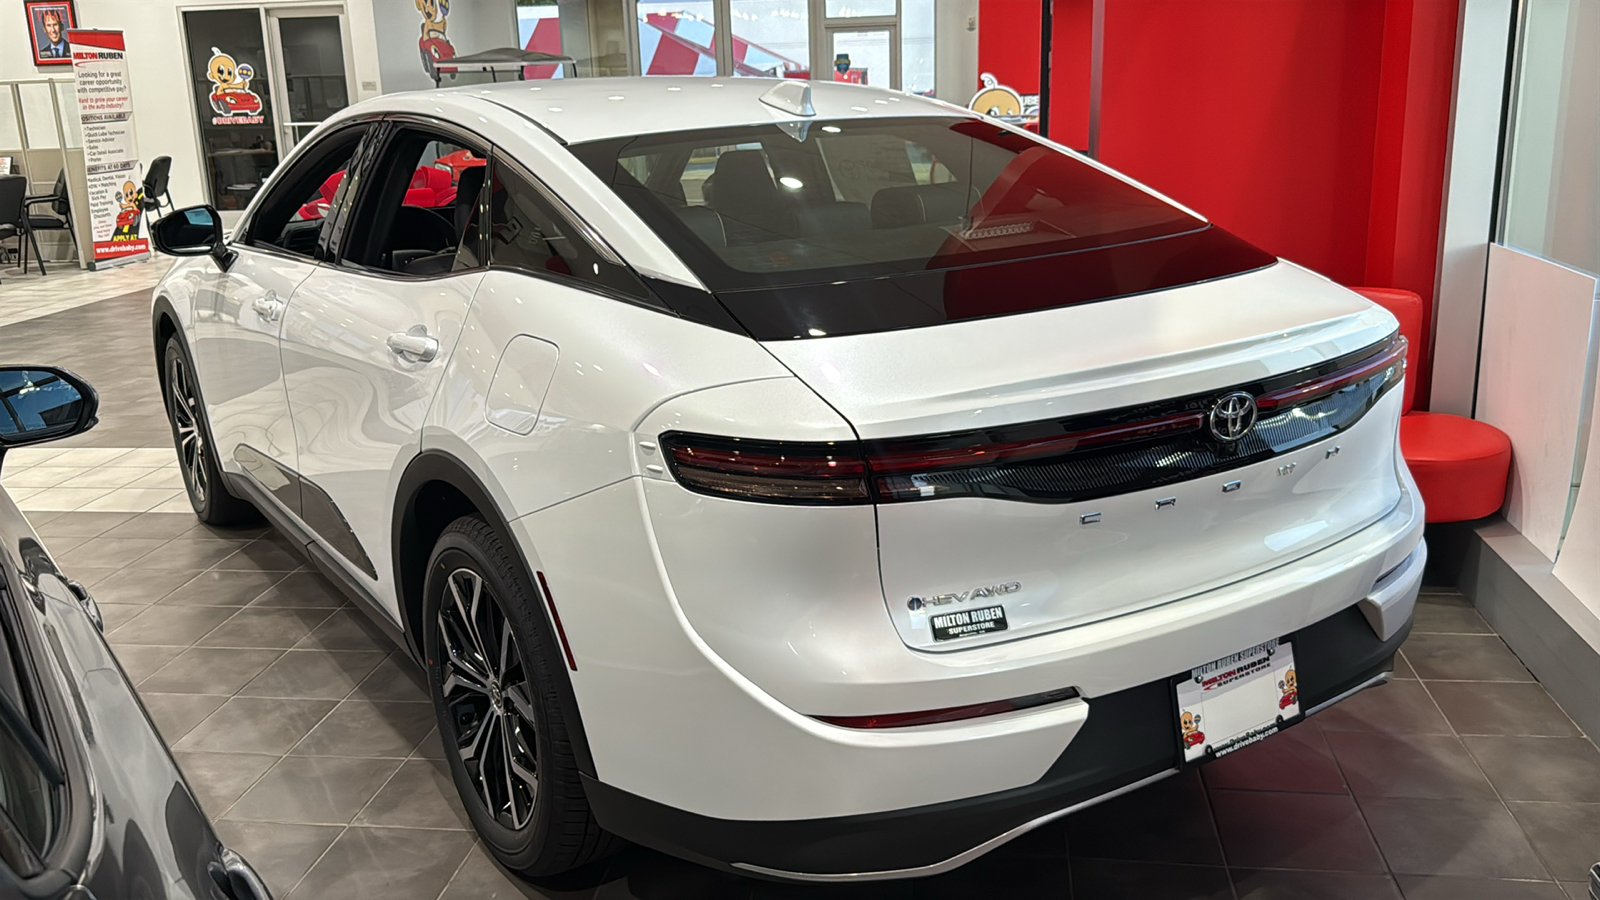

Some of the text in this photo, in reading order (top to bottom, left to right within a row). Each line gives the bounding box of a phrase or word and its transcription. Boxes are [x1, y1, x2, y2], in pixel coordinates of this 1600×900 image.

[36, 10, 67, 22] TIME
[96, 244, 146, 253] www.drivebaby.com
[921, 581, 1021, 607] HEV AWD
[933, 607, 1003, 629] MILTON RUBEN
[948, 621, 995, 635] SUPERSTORE
[1202, 656, 1270, 687] MILTON RUBEN
[1217, 654, 1239, 669] RUBEN
[1217, 662, 1271, 687] SUPERSTORE
[1215, 727, 1278, 758] www.drivebaby.com
